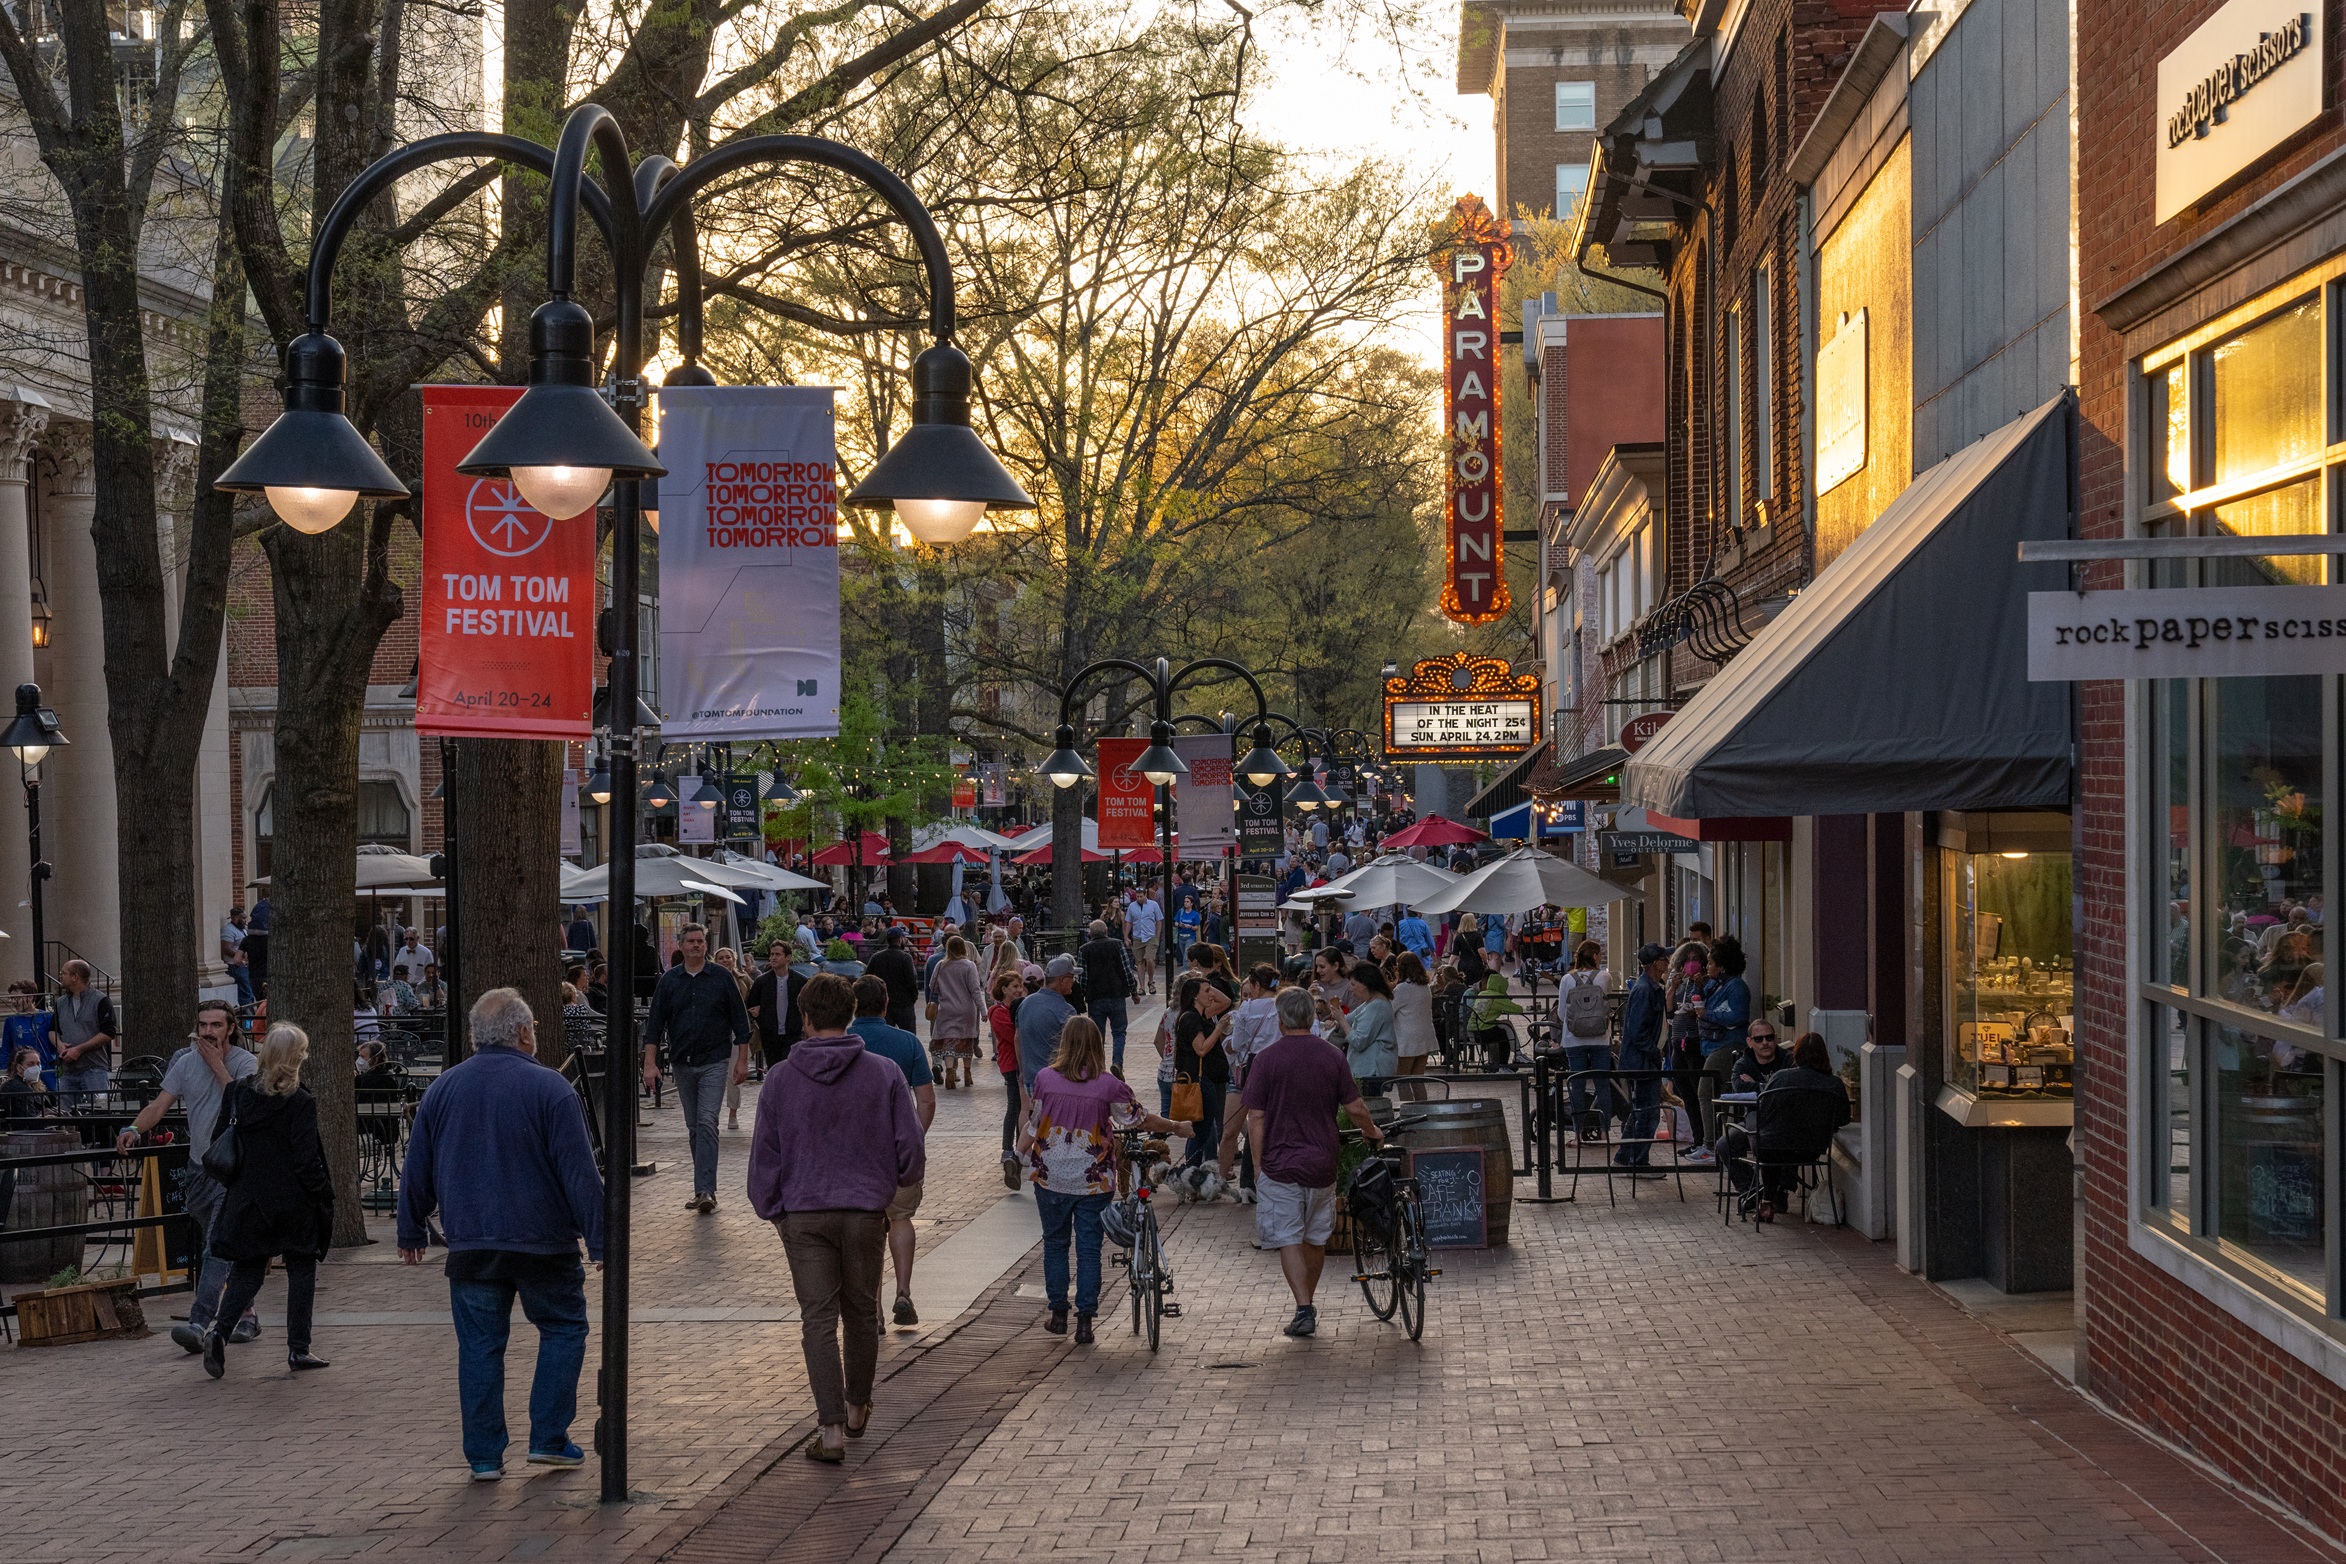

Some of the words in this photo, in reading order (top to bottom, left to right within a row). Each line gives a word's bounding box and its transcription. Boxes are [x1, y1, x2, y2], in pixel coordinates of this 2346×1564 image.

[464, 412, 498, 429] 10th
[1454, 253, 1491, 602] PARAMOUNT
[442, 573, 501, 601] TOM
[510, 575, 569, 603] TOM
[446, 608, 574, 638] FESTIVAL
[453, 690, 493, 710] April
[691, 708, 803, 720] @TOMTOMFOUNDATION
[1429, 706, 1440, 715] IN
[1445, 705, 1466, 715] THE
[1470, 705, 1499, 715] HEAT
[1417, 719, 1433, 728] OF
[1438, 719, 1459, 728] THE
[1466, 718, 1499, 728] NIGHT
[1505, 718, 1526, 727] 25¢
[1633, 721, 1661, 736] Kil
[1440, 732, 1471, 741] APRIL
[1105, 797, 1125, 807] TOM
[1127, 797, 1148, 807] TOM
[1106, 808, 1149, 818] FESTIVAL
[1245, 819, 1261, 827] TOM
[1262, 819, 1278, 827] TOM
[1246, 827, 1280, 836] FESTIVAL
[1609, 835, 1637, 847] Yves
[1639, 835, 1693, 848] Delorme
[1430, 1169, 1456, 1180] SEATING
